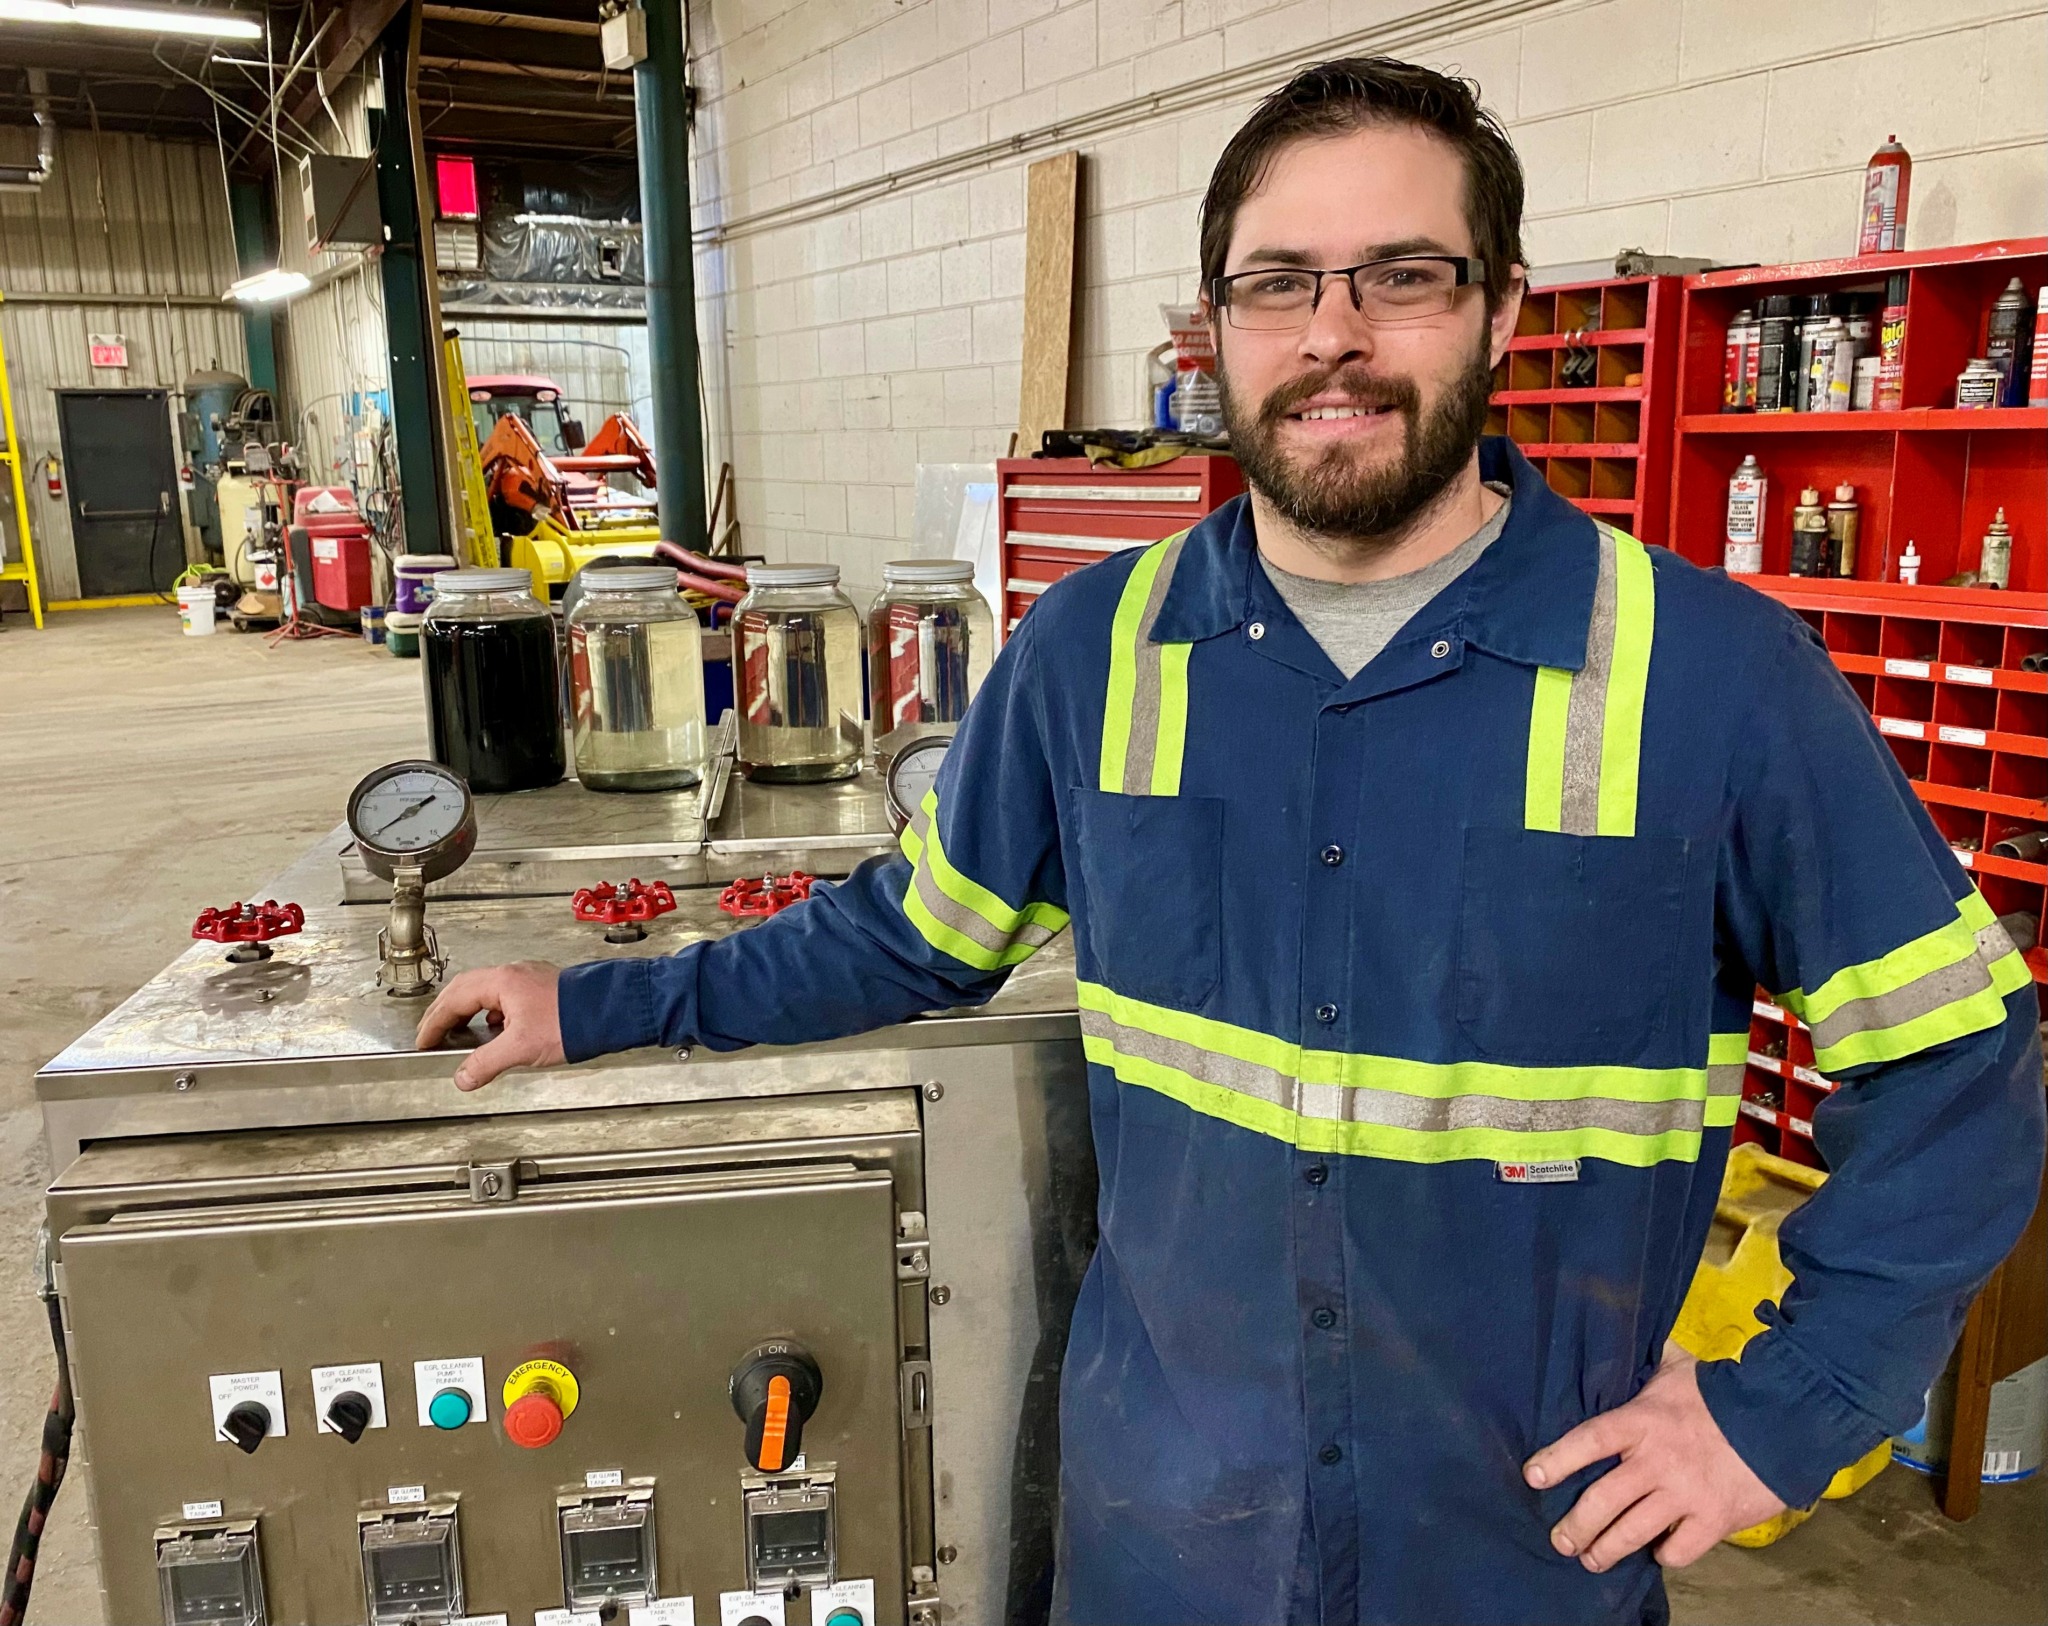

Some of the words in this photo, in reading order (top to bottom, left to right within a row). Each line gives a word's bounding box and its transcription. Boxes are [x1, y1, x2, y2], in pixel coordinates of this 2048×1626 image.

[1503, 1166, 1525, 1178] 3M
[1529, 1164, 1573, 1174] Scotchlite
[768, 1345, 787, 1354] ON
[441, 1362, 474, 1370] CLEANING
[338, 1368, 372, 1376] CLEANING
[508, 1362, 569, 1385] EMERGENCY
